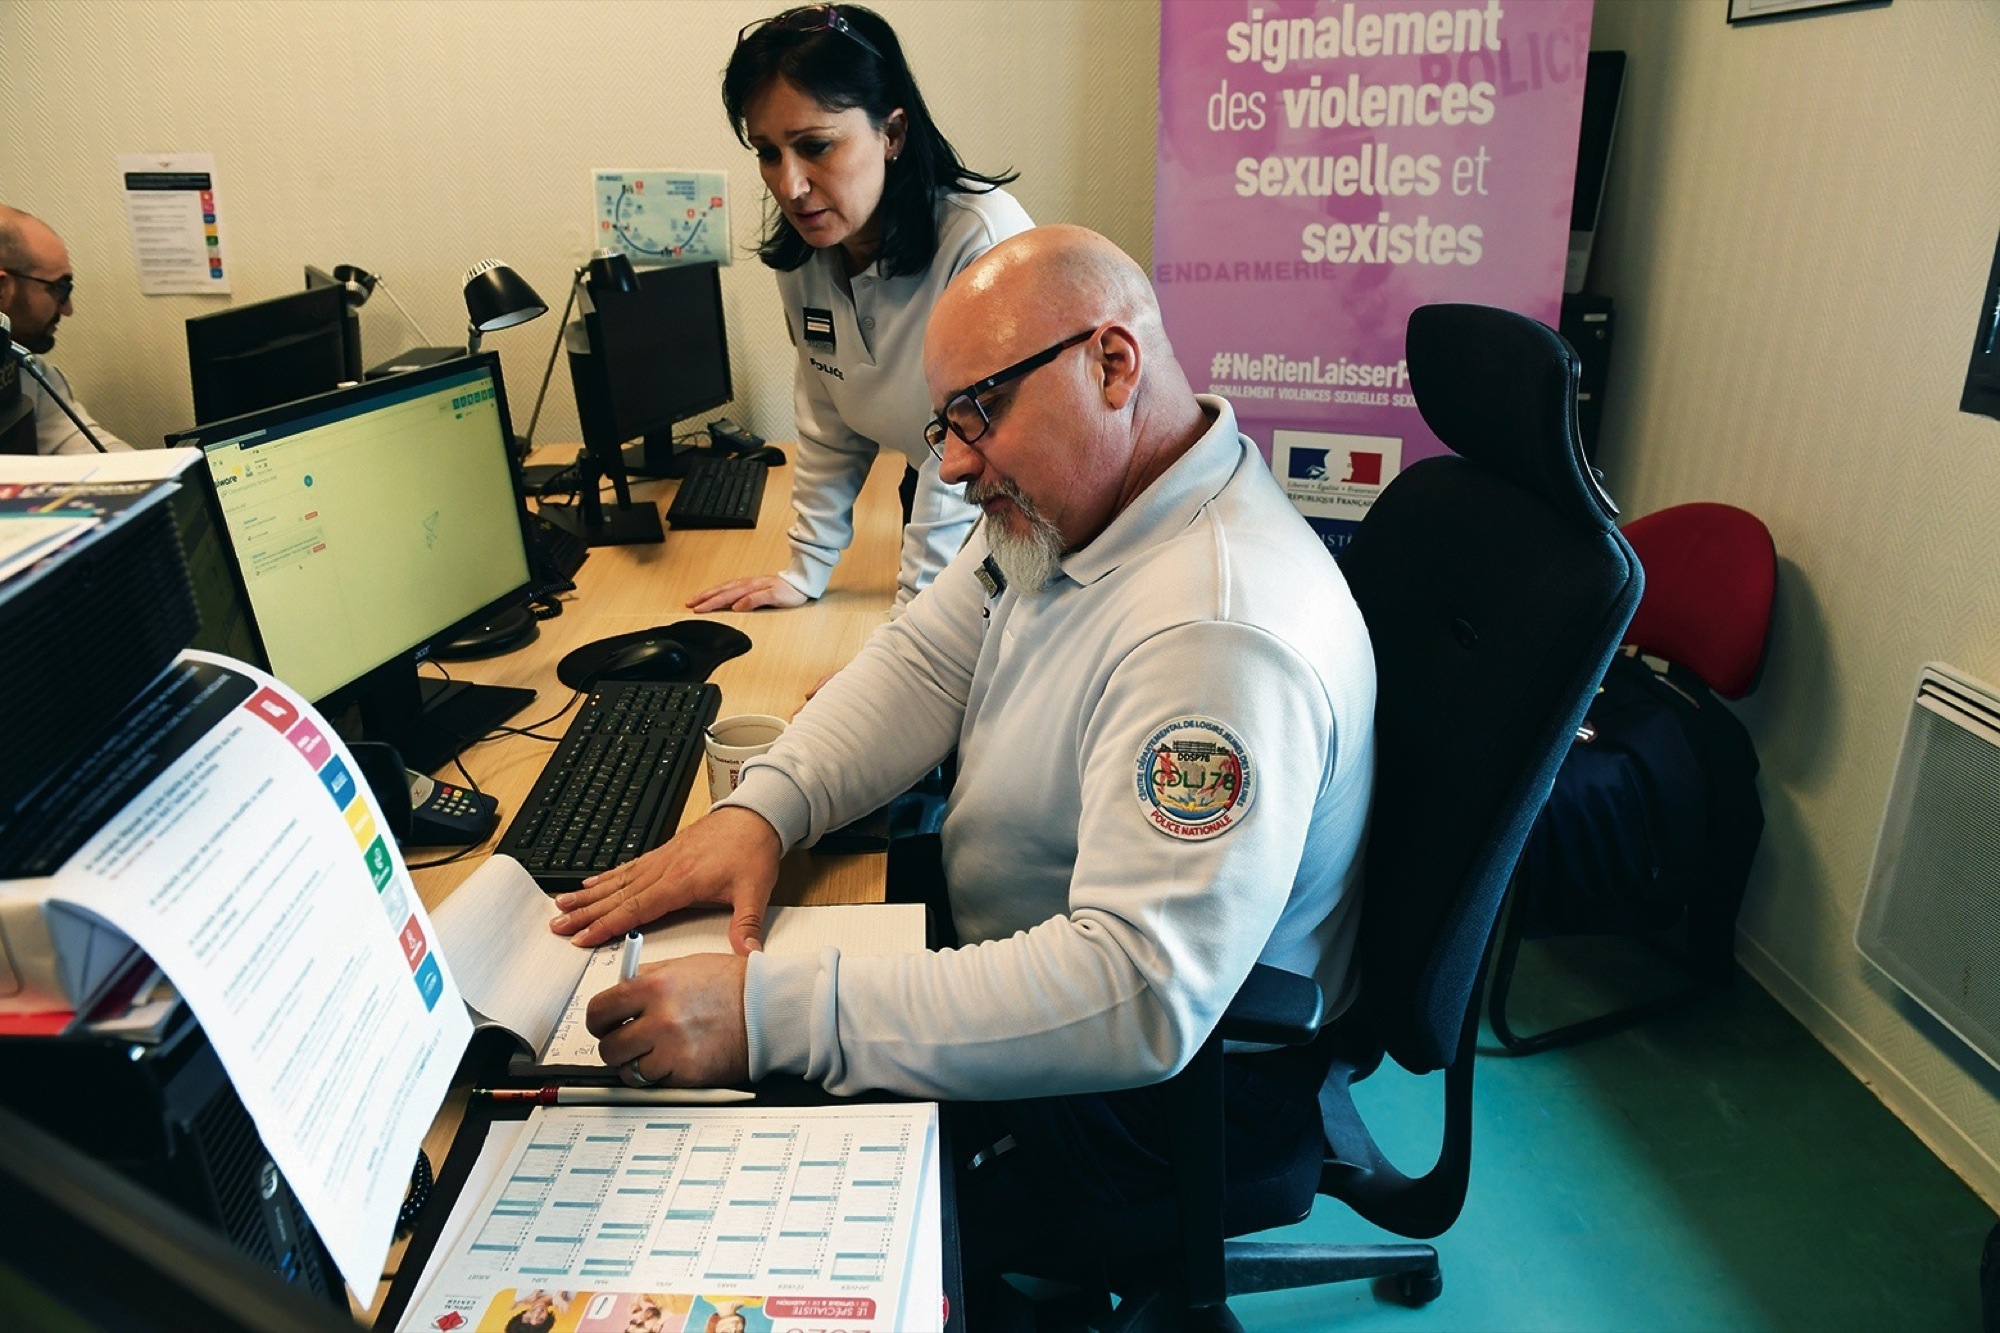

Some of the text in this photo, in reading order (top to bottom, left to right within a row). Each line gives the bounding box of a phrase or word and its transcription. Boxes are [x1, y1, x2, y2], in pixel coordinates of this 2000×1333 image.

[1226, 0, 1504, 74] signalement
[1208, 73, 1497, 131] des violences
[1234, 142, 1491, 197] sexuelles et
[1301, 211, 1484, 266] sexistes
[1208, 384, 1276, 399] SIGNALEMENT
[1279, 386, 1331, 401] VIOLENCES
[1334, 389, 1389, 406] SEXUELLES
[1151, 810, 1233, 836] POLICE NATIONALE
[792, 1306, 867, 1318] LE SPÉCIALISTE
